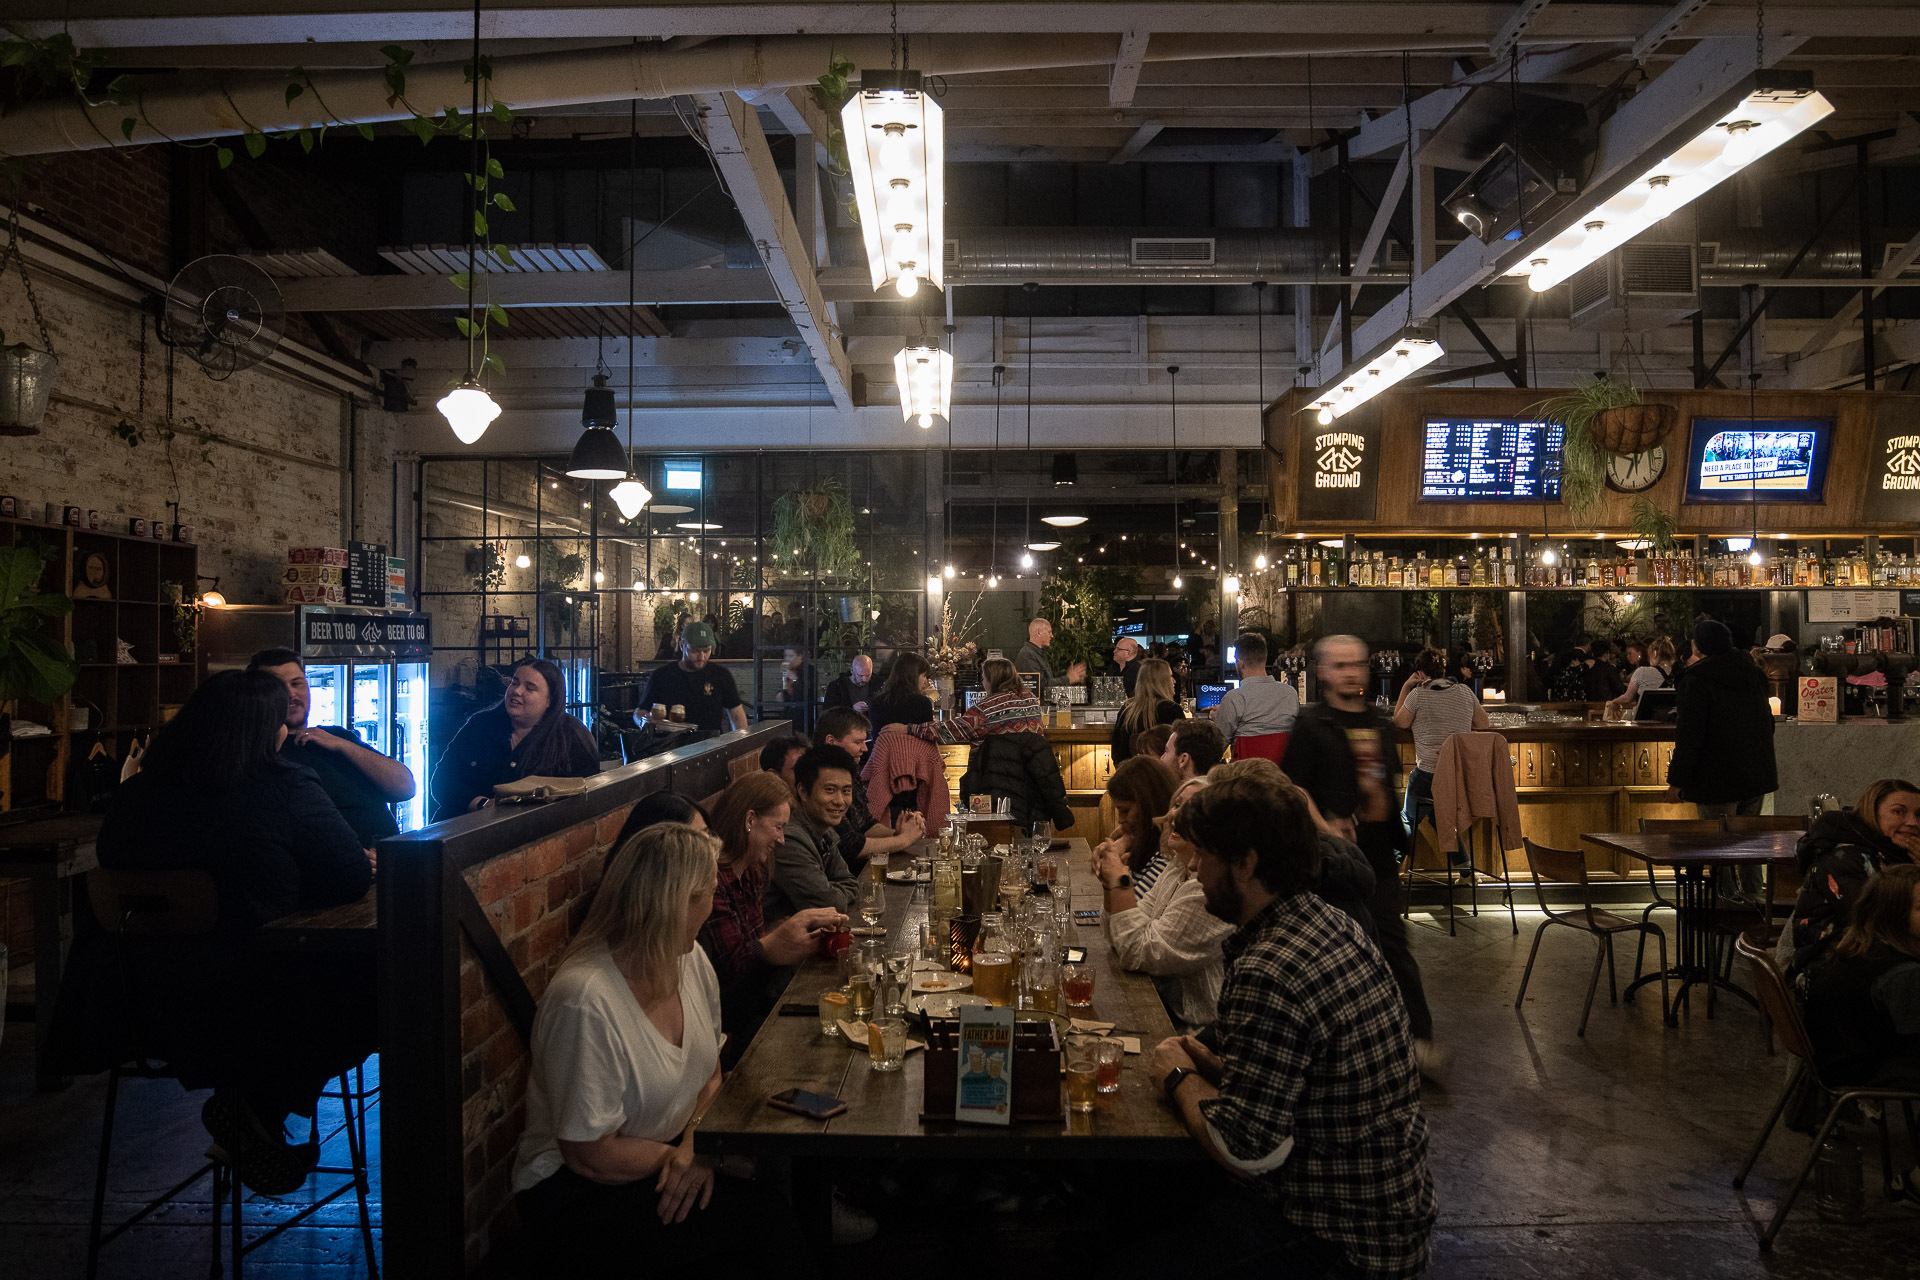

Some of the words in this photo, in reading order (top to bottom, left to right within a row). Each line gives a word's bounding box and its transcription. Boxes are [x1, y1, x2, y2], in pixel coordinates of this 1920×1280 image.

[1315, 432, 1365, 451] STOMPING
[1886, 435, 1920, 454] STOMP
[1704, 465, 1719, 473] NEED
[1725, 463, 1742, 471] PLACE
[1315, 471, 1361, 488] GROUND
[1882, 473, 1920, 490] GROUN
[311, 622, 332, 640] BEER
[333, 622, 344, 640] TO
[345, 622, 356, 640] GO
[387, 624, 405, 640] BEER
[406, 624, 415, 640] TO
[416, 624, 425, 640] GO
[1801, 686, 1835, 699] Oyster
[963, 1029, 995, 1041] FATHER'S
[995, 1029, 1009, 1041] DAY
